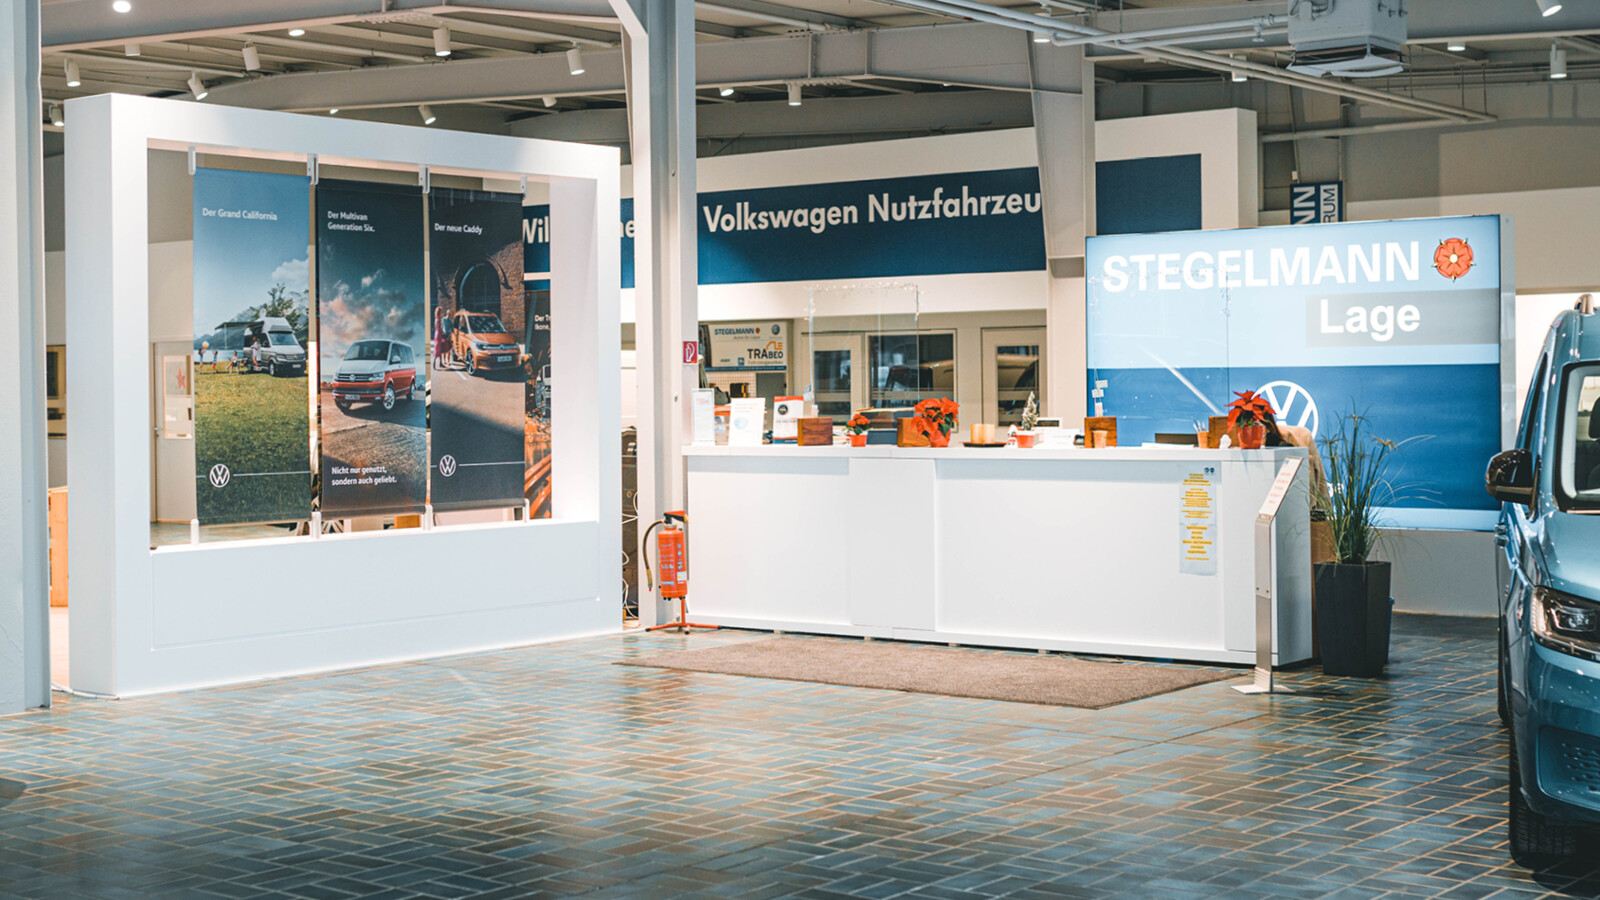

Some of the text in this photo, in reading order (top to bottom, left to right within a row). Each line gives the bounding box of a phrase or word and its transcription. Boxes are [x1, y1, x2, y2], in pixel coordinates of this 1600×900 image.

[202, 207, 278, 221] Der Grand California
[327, 210, 368, 221] Der Multivan
[702, 185, 1041, 234] Volkswagen Nutzfahrzeu
[327, 221, 376, 232] Generation Six.
[434, 222, 446, 231] Der
[463, 224, 483, 236] Caddy
[1102, 241, 1420, 293] STEGELMANN
[1319, 299, 1421, 342] Lage
[714, 328, 754, 336] STEGELMANN
[331, 466, 349, 474] Nicht
[361, 465, 387, 475] genutzt,
[331, 475, 397, 486] sondern auch geliebt.
